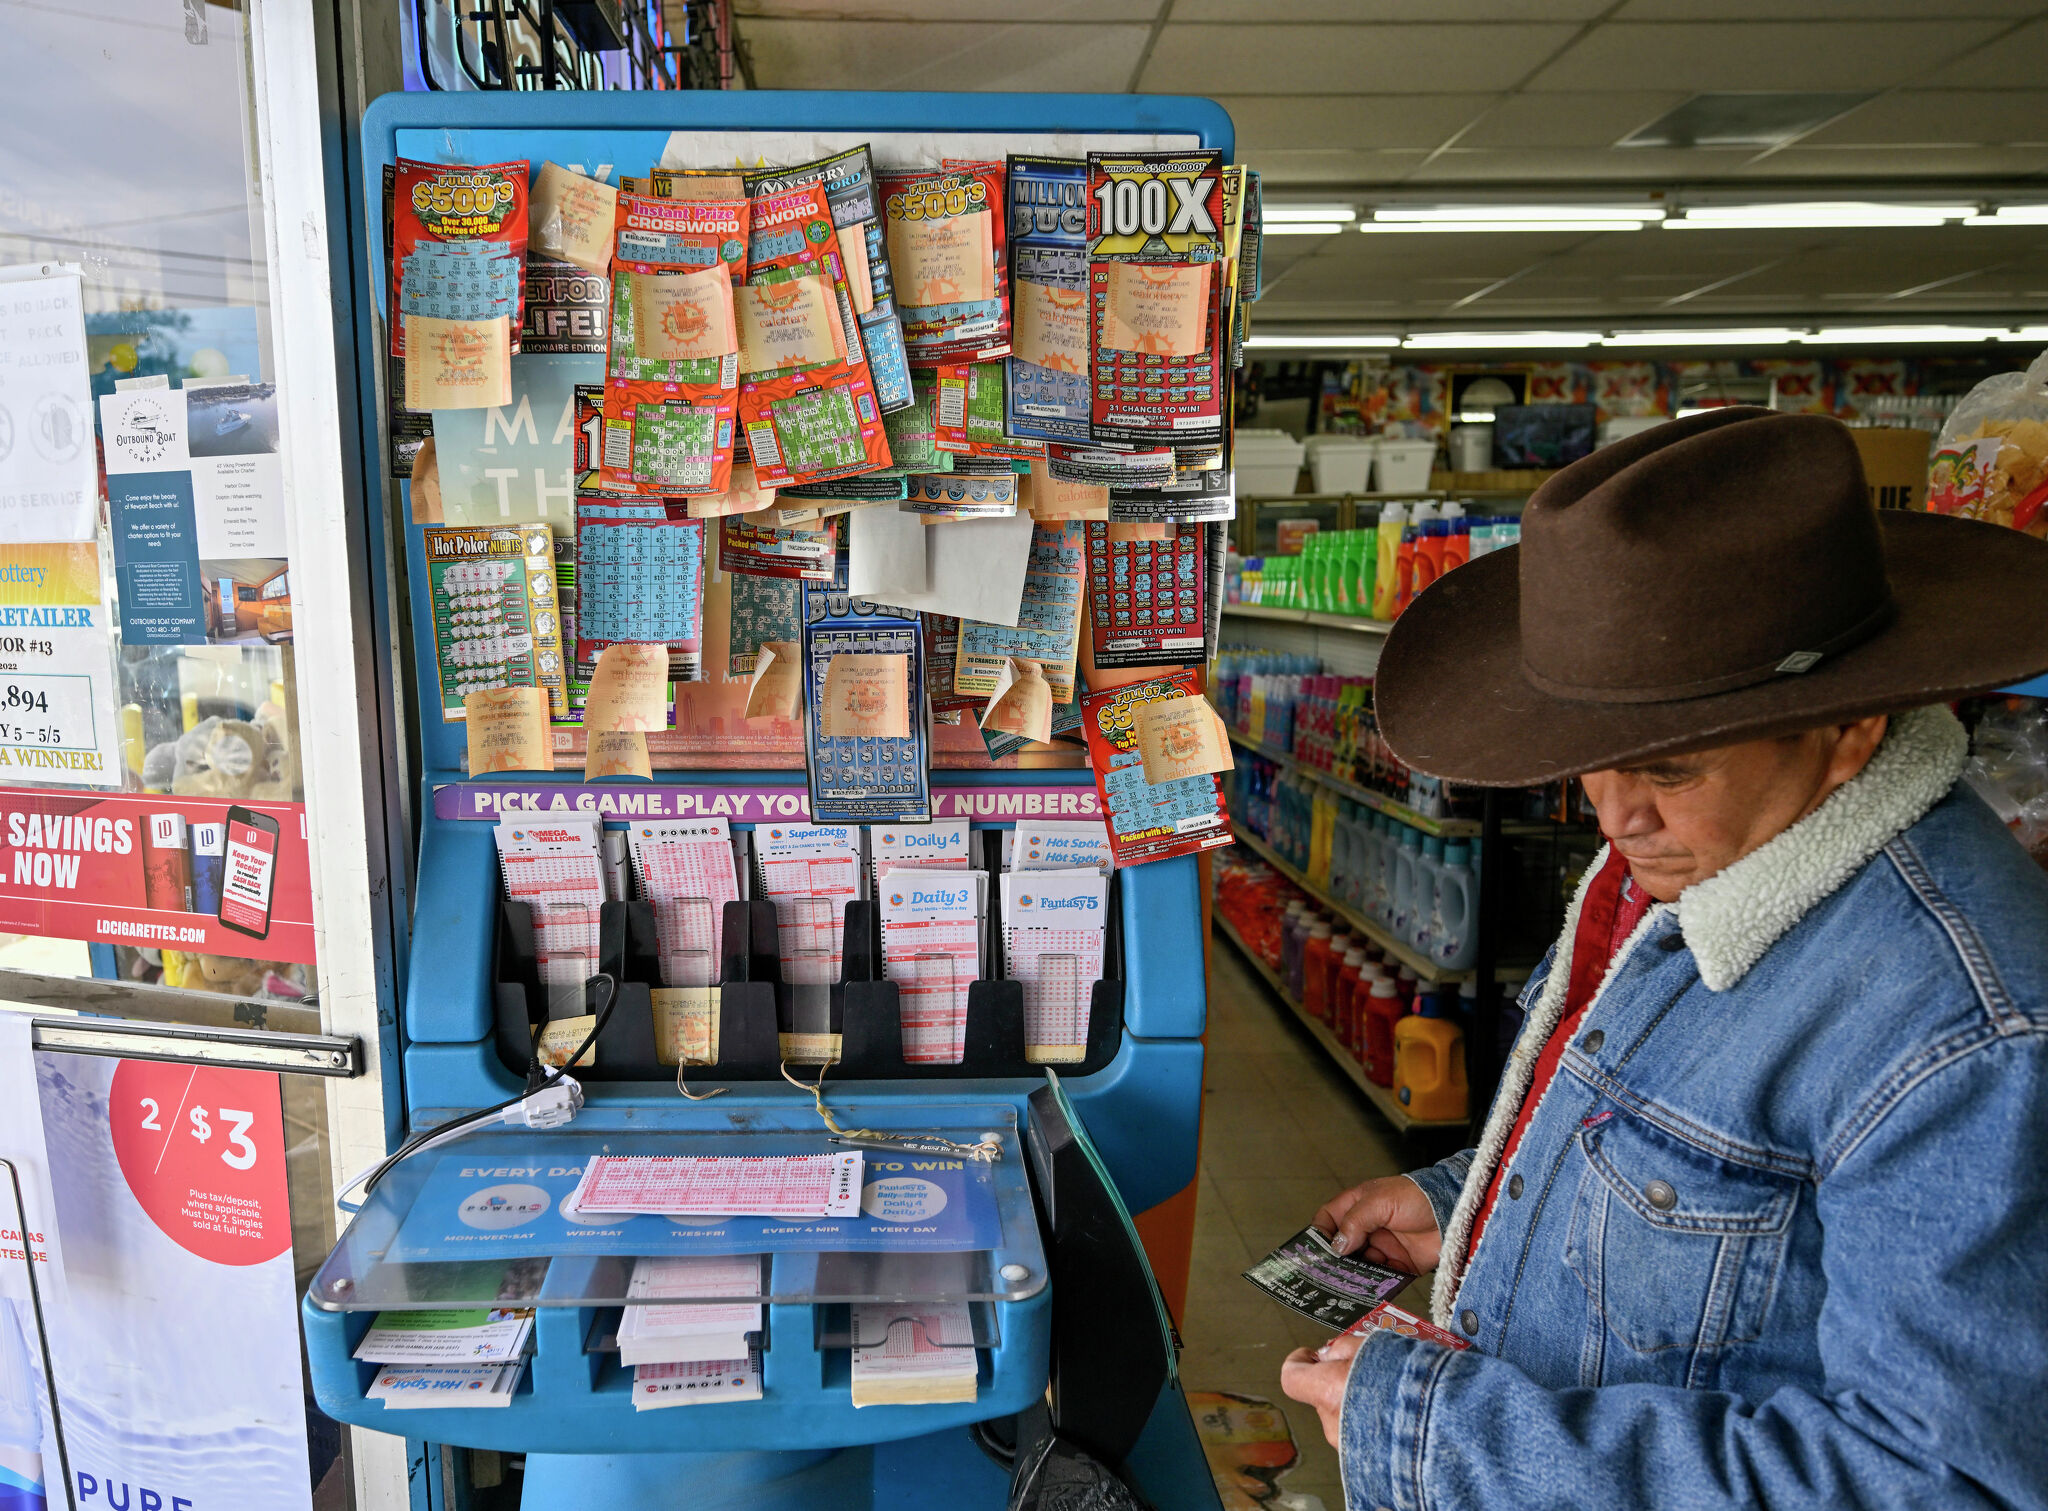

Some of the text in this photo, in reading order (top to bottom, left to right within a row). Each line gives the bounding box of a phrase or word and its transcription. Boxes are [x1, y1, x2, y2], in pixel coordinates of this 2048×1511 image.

[1104, 163, 1206, 173] WIN UP TO $5,000,000!
[438, 175, 490, 187] FULL OF
[909, 178, 960, 196] FULL OF
[412, 181, 514, 215] $500'S
[769, 194, 810, 213] Prize
[1094, 177, 1218, 236] 100X
[633, 201, 734, 220] Instant Prize
[428, 223, 500, 235] Top Prizes of $500!
[441, 216, 488, 226] Over 30,000
[627, 214, 740, 233] CROSSWORD
[552, 277, 604, 302] FOR
[570, 344, 607, 352] EDITION
[1122, 405, 1162, 413] CHANCES
[128, 447, 166, 463] COMPANY
[20, 491, 84, 508] SERVICE
[433, 536, 521, 556] Hot Poker NIGHTS
[728, 538, 749, 549] Packed
[0, 608, 94, 628] ETAILER
[30, 640, 53, 656] #13
[1116, 686, 1160, 706] FULL OF
[14, 728, 22, 741] 5
[39, 725, 60, 743] 5/5
[1116, 739, 1129, 749] Top
[14, 748, 104, 771] WINNER!
[474, 792, 540, 813] PICK
[552, 793, 571, 812] A
[576, 794, 671, 815] GAME.
[676, 794, 748, 815] PLAY
[954, 794, 1102, 815] NUMBERS.
[8, 812, 133, 856] SAVINGS
[788, 828, 848, 839] SuperLotto
[904, 832, 960, 850] Daily 4
[1120, 828, 1161, 844] Packed with
[1046, 838, 1100, 848] Hot Spot
[232, 849, 267, 866] Keep Your
[1046, 852, 1099, 864] Hot Spot
[13, 850, 81, 890] NOW
[235, 860, 262, 874] Receipt
[233, 875, 246, 884] CASH
[911, 890, 968, 907] Daily 3
[1040, 896, 1098, 910] Fantasy 5
[97, 919, 205, 944] LDCIGARETTES.COM
[140, 1097, 162, 1131] 2
[459, 1167, 544, 1178] EVERY
[871, 1162, 904, 1172] TO
[912, 1161, 964, 1171] WIN
[189, 1188, 262, 1210] Plus tax/deposit,
[181, 1207, 263, 1230] Must buy 2. Singles
[187, 1200, 262, 1221] where applicable.
[192, 1220, 264, 1241] sold at full price.
[442, 1380, 463, 1389] Hot
